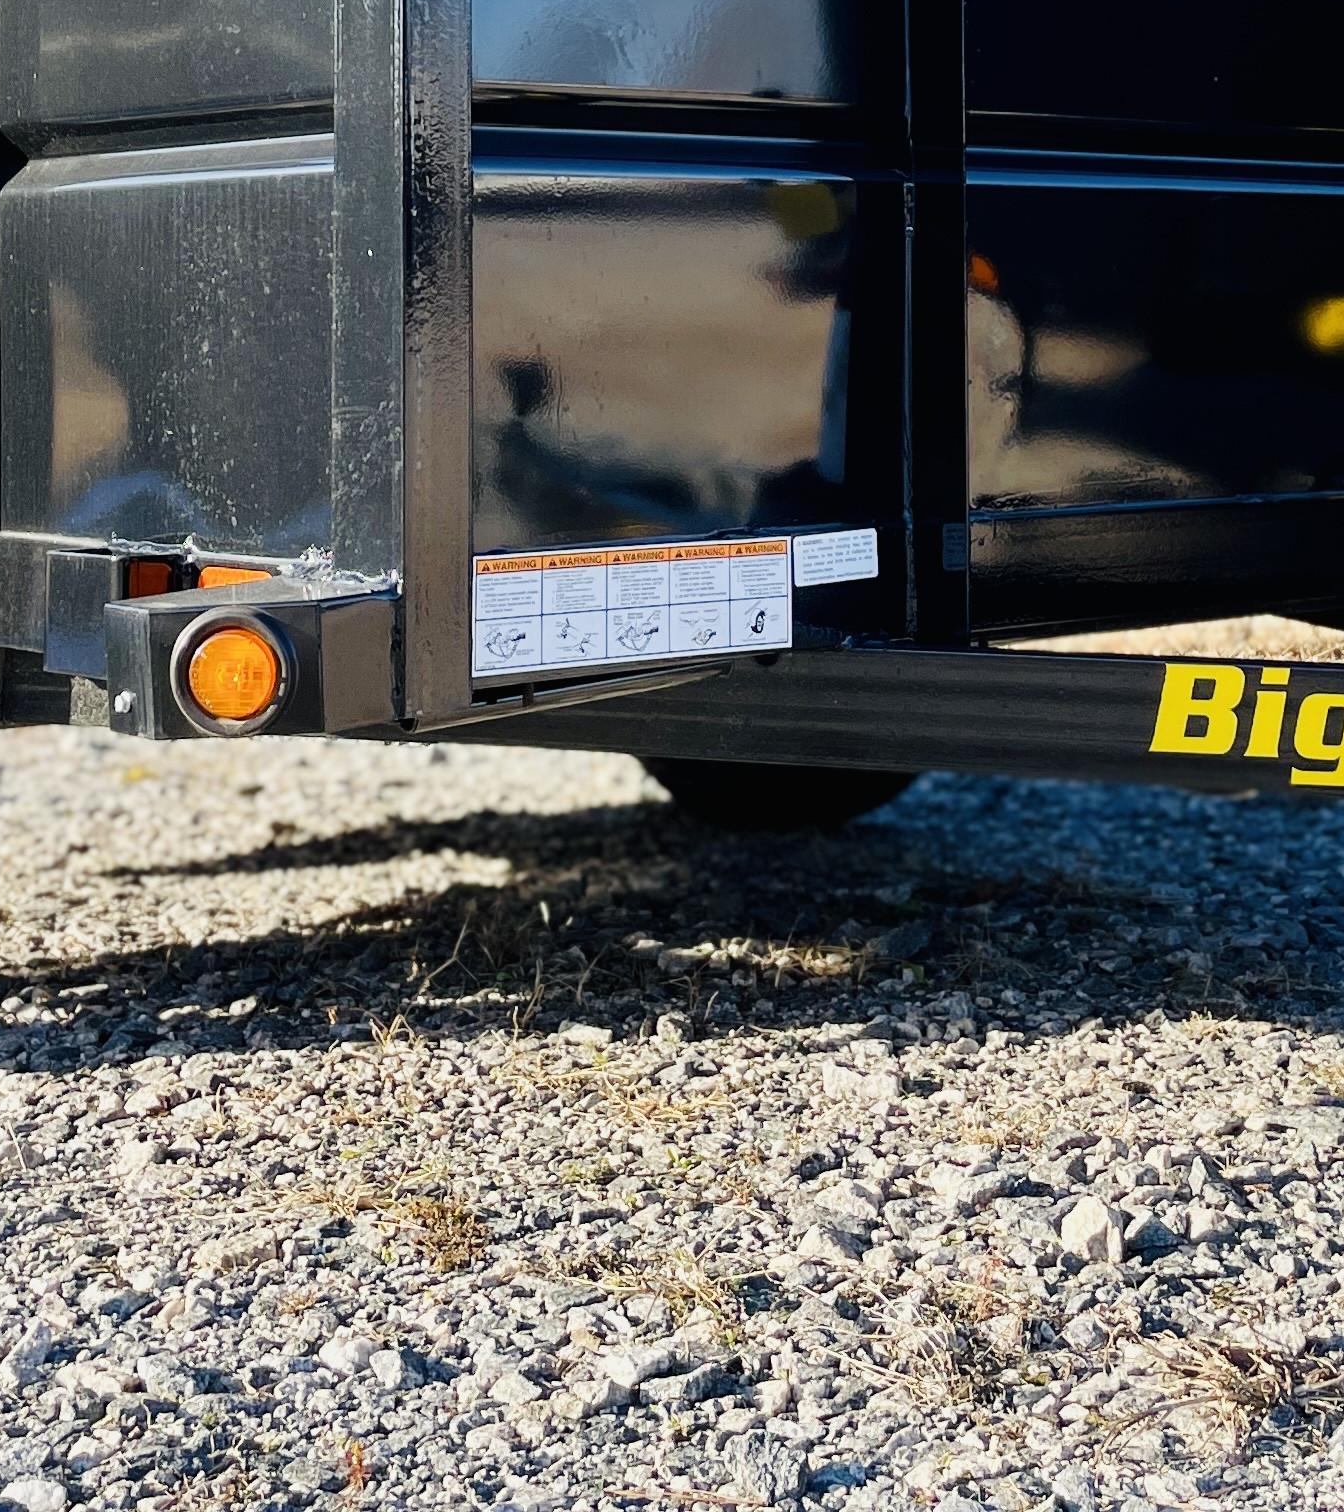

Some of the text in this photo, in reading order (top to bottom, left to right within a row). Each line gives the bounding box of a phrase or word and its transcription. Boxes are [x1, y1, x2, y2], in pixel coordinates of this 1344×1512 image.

[684, 547, 726, 559] WARNING
[744, 543, 784, 555] WARNING
[558, 555, 602, 568] WARNING
[622, 551, 665, 564] WARNING
[492, 558, 537, 571] WARNING
